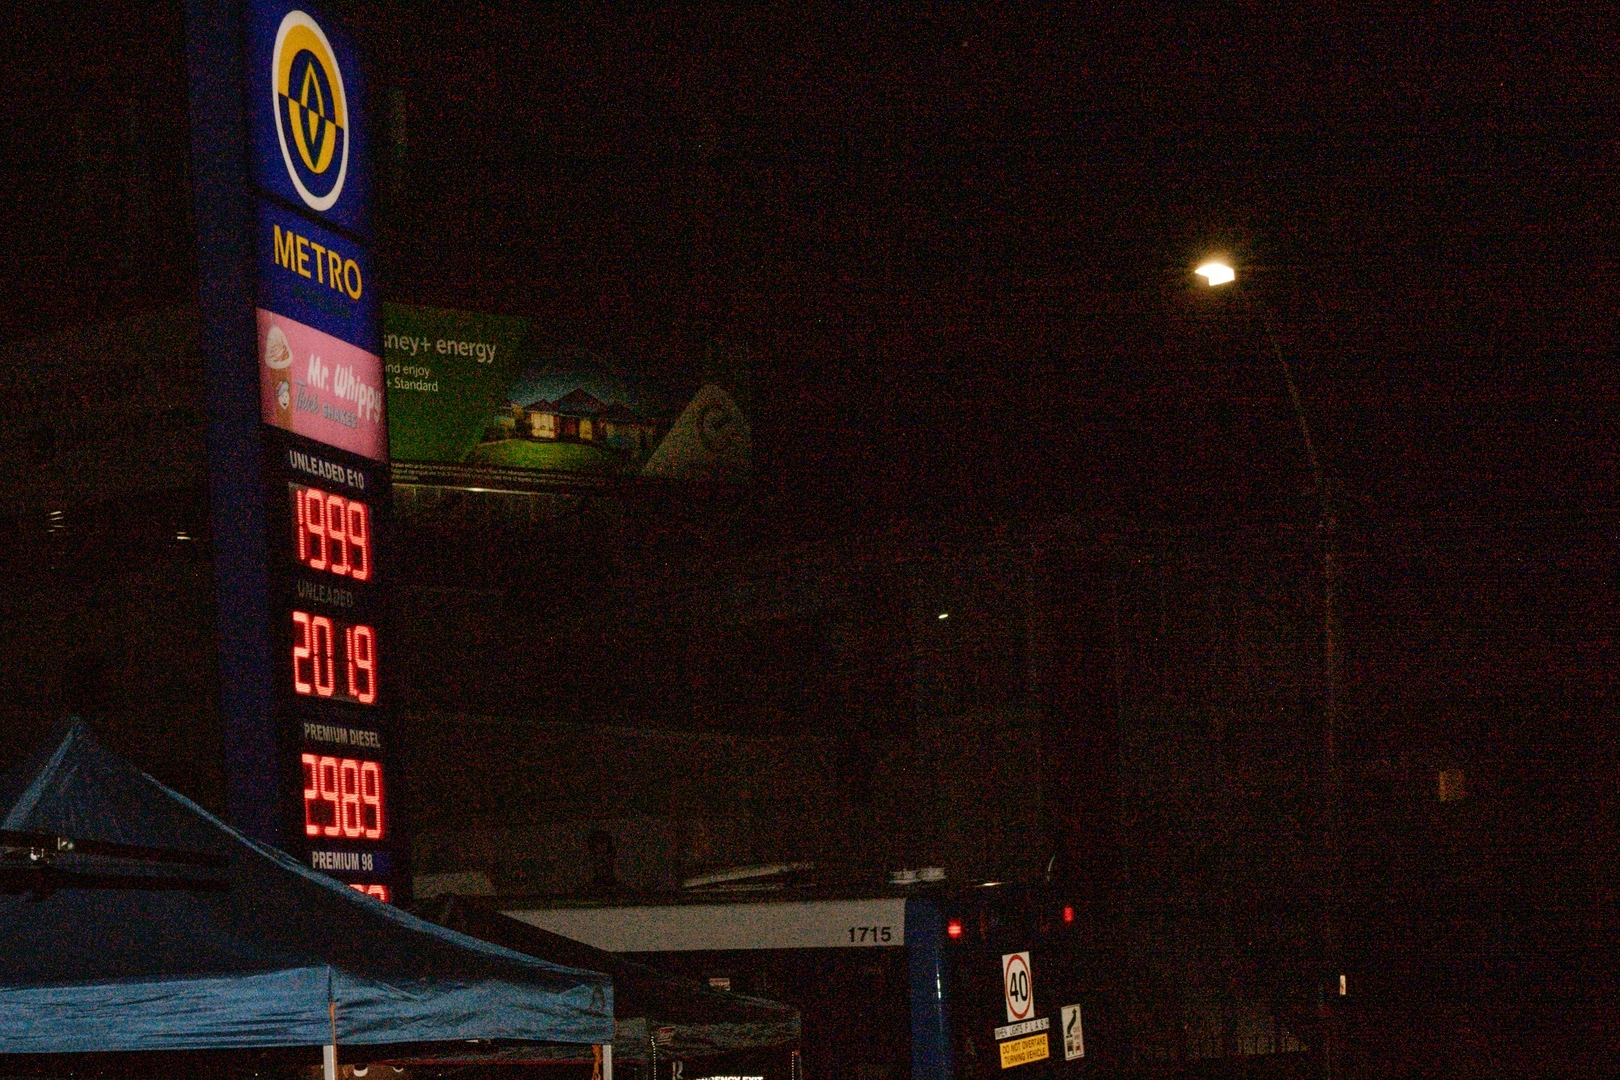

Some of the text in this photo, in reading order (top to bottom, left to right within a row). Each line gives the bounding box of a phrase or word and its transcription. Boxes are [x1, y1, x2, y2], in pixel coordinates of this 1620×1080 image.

[273, 224, 363, 300] METRO
[437, 339, 496, 364] energy
[394, 376, 438, 392] Standard
[402, 364, 431, 379] enjoy
[307, 353, 381, 423] Mr. Whippy
[289, 450, 345, 484] UNLEADED
[347, 468, 365, 490] E10
[297, 578, 353, 608] UNLEADED
[303, 722, 380, 748] PREMIUM DIESEL
[312, 851, 373, 871] PREMIUM 98
[848, 926, 892, 943] 1715
[1010, 970, 1028, 1002] 40
[1002, 1036, 1046, 1054] DO NOT OVERTAKE
